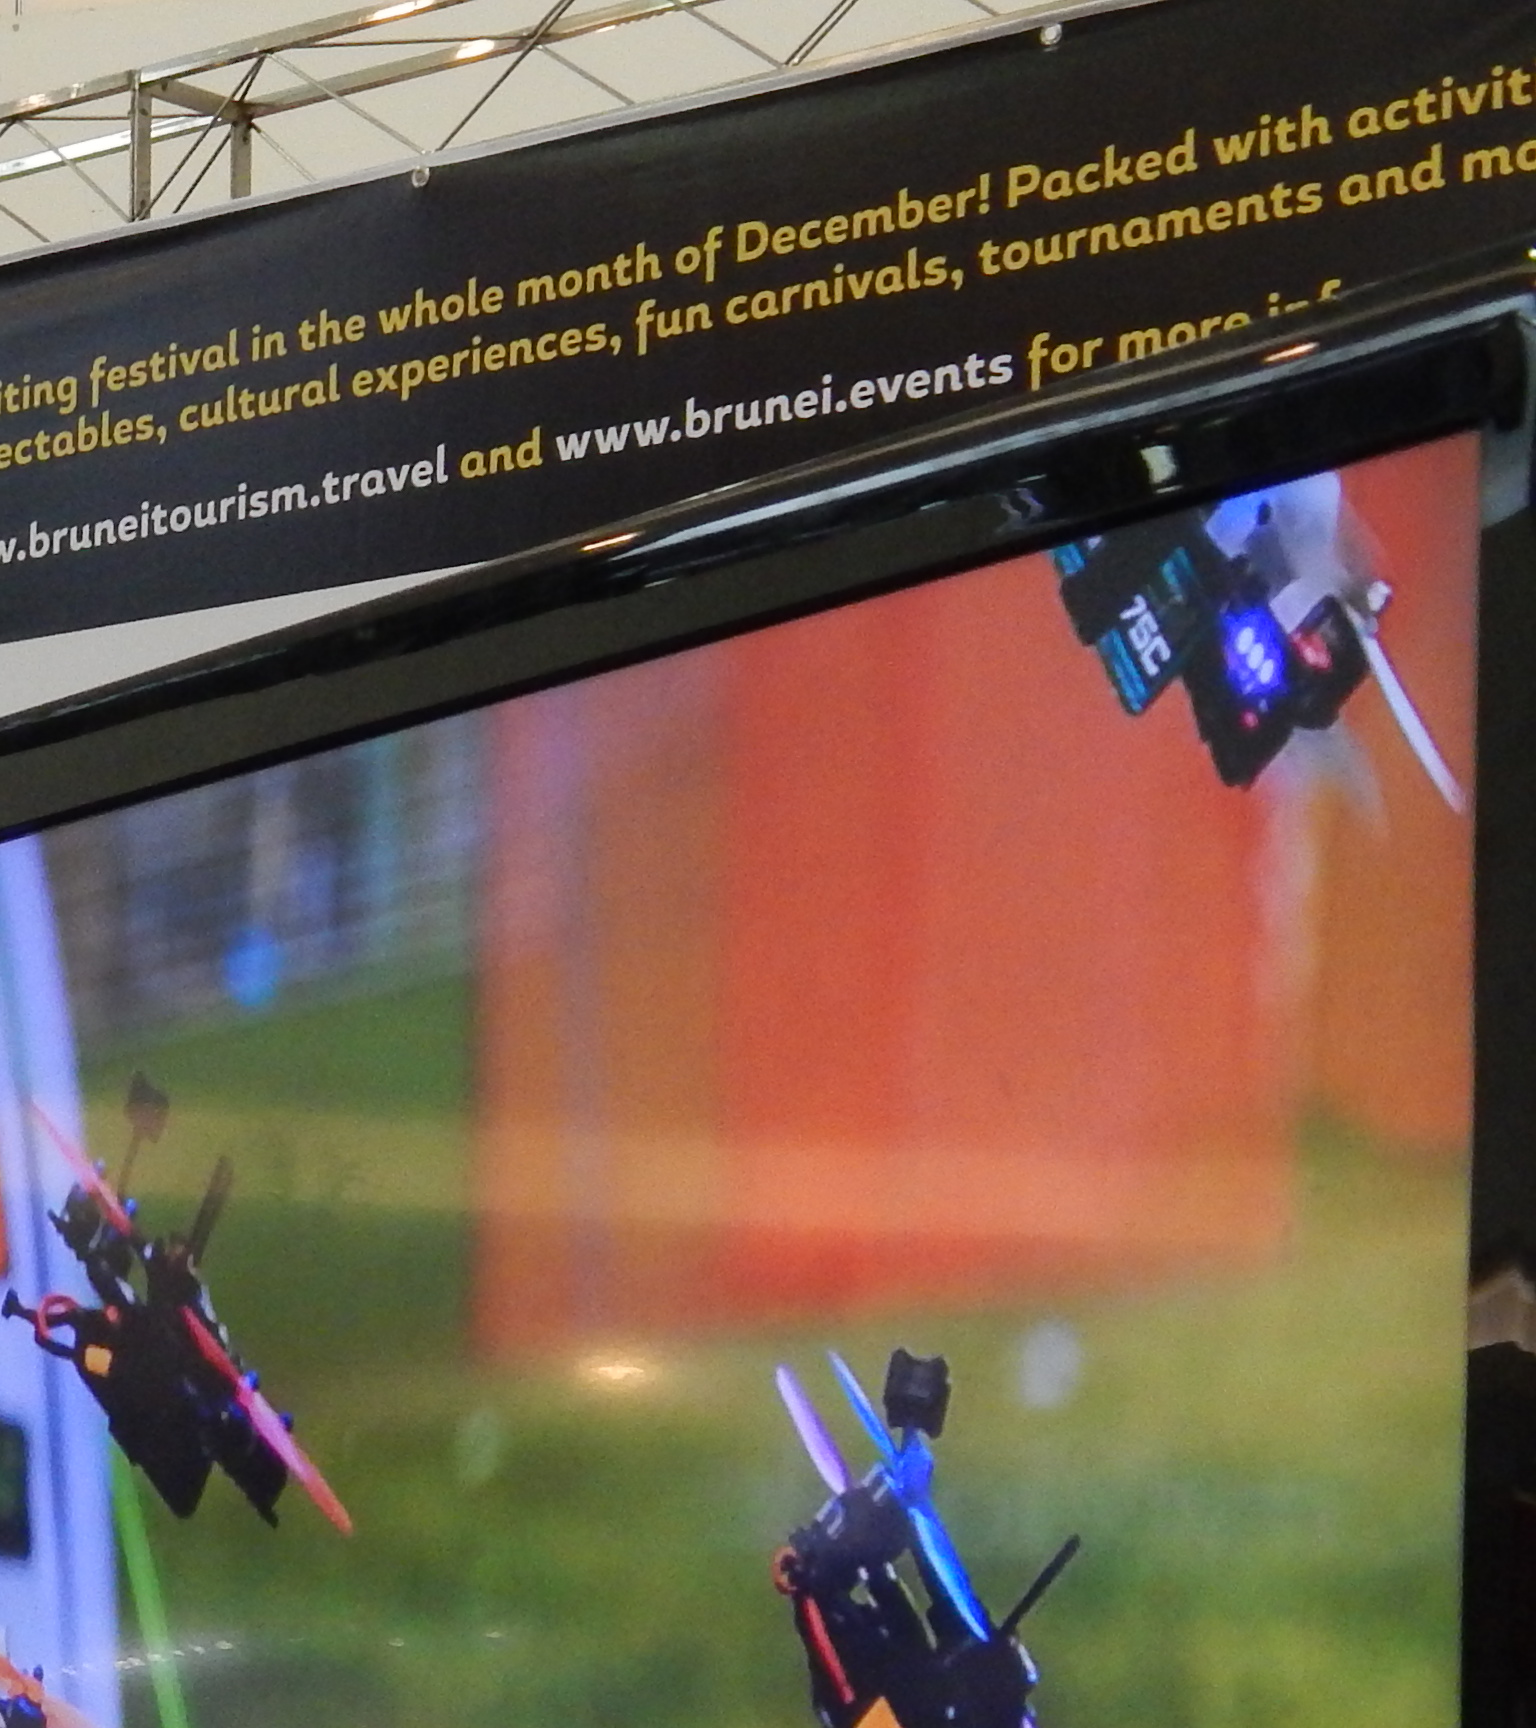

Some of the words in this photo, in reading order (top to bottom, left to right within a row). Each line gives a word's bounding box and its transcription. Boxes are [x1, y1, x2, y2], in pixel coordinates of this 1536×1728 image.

[90, 328, 240, 407] festival
[252, 323, 288, 362] in
[299, 309, 366, 351] the
[378, 277, 505, 334] whole
[517, 241, 663, 306] month
[675, 225, 726, 283] of
[736, 172, 991, 262] December!
[1008, 127, 1198, 209] Packed
[1213, 103, 1333, 165] with
[180, 364, 340, 432] cultural
[352, 322, 623, 401] experiences,
[636, 299, 714, 356] fun
[725, 246, 965, 325] carnivals,
[979, 182, 1323, 275] tournaments
[1339, 142, 1446, 206] and
[460, 426, 544, 479] and
[556, 353, 1015, 463] www.brunei.events
[1028, 332, 1105, 392] for
